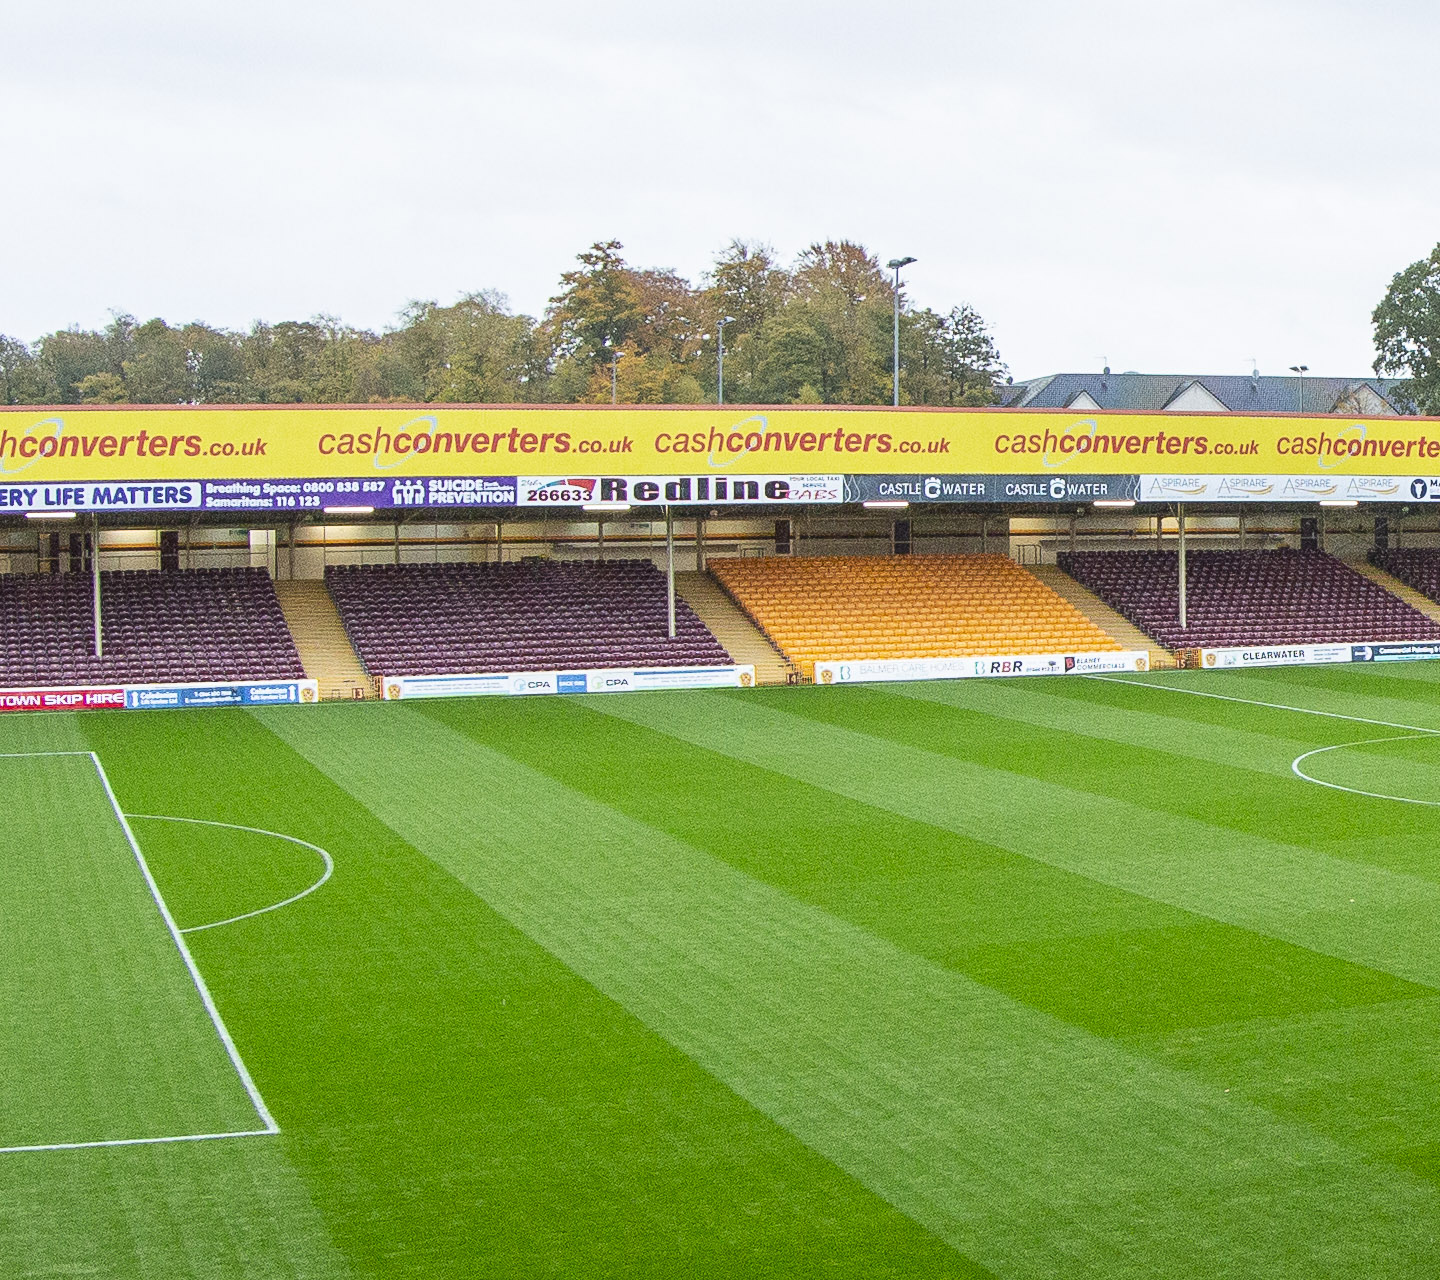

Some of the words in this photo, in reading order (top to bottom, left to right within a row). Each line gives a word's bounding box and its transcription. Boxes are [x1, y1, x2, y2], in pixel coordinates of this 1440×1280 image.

[318, 426, 634, 455] cashconverters.co.uk
[654, 426, 951, 454] cashconverters.co.uk
[994, 428, 1259, 455] cashconverters.co.uk
[205, 482, 261, 495] Breathing
[262, 483, 301, 495] Space:
[302, 482, 333, 493] 0800
[362, 481, 386, 493] 587
[428, 479, 485, 492] SUICIDE
[526, 489, 593, 502] 266633
[600, 476, 791, 502] Redline
[879, 482, 921, 495] CASTLE
[942, 483, 986, 495] WATER
[1005, 483, 1047, 496] CASTLE
[1067, 483, 1108, 495] WATER
[1149, 477, 1201, 494] ASPIRARE
[1216, 477, 1268, 495] ASPIRARE
[1282, 477, 1332, 494] ASPIRARE
[1346, 477, 1393, 494] ASPIRARE
[45, 487, 85, 506] LIFE
[92, 485, 193, 505] MATTERS
[205, 496, 273, 508] Samaritans:
[275, 496, 296, 507] 116
[298, 496, 321, 507] 123
[428, 491, 515, 504] PREVENTION
[1241, 649, 1306, 662] CLEARWATER
[901, 663, 928, 673] CARE
[990, 660, 1023, 674] RBR
[527, 680, 552, 690] CPA
[605, 677, 630, 688] CPA
[44, 694, 83, 706] SKIP
[86, 692, 124, 704] HIRE
